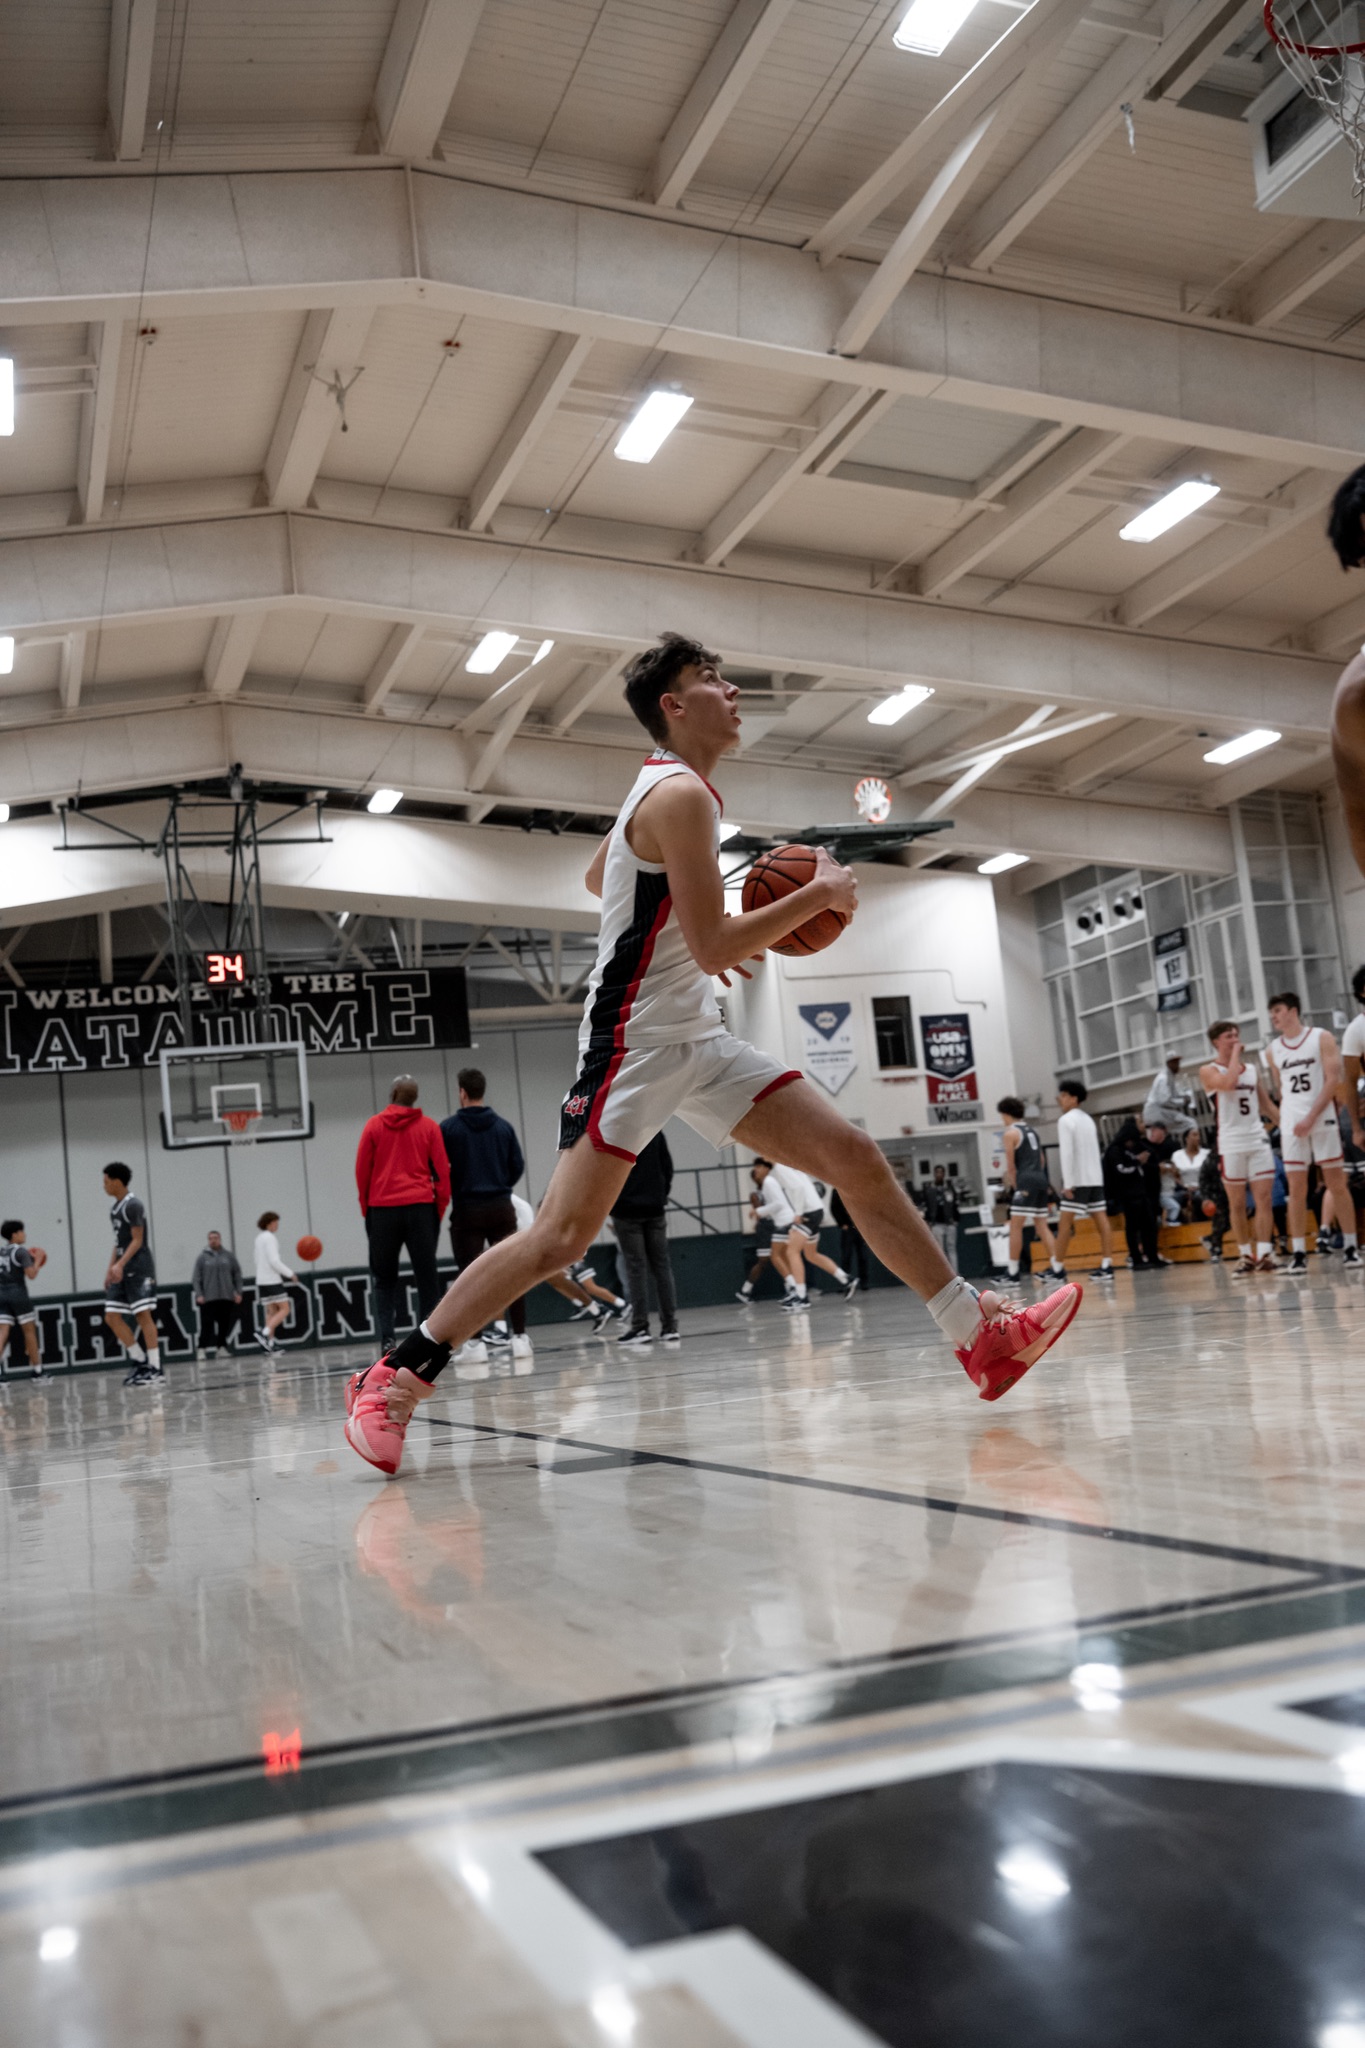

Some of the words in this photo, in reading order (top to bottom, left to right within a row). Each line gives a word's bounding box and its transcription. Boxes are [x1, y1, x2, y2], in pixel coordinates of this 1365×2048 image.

[207, 954, 244, 983] 34
[25, 983, 210, 1009] WELCOME
[283, 973, 356, 994] THE
[0, 970, 435, 1073] ATADOME
[929, 1043, 967, 1058] OPEN
[938, 1082, 966, 1093] FIRST
[1289, 1073, 1311, 1093] 25
[936, 1092, 970, 1104] PLACE
[1239, 1097, 1250, 1116] 5
